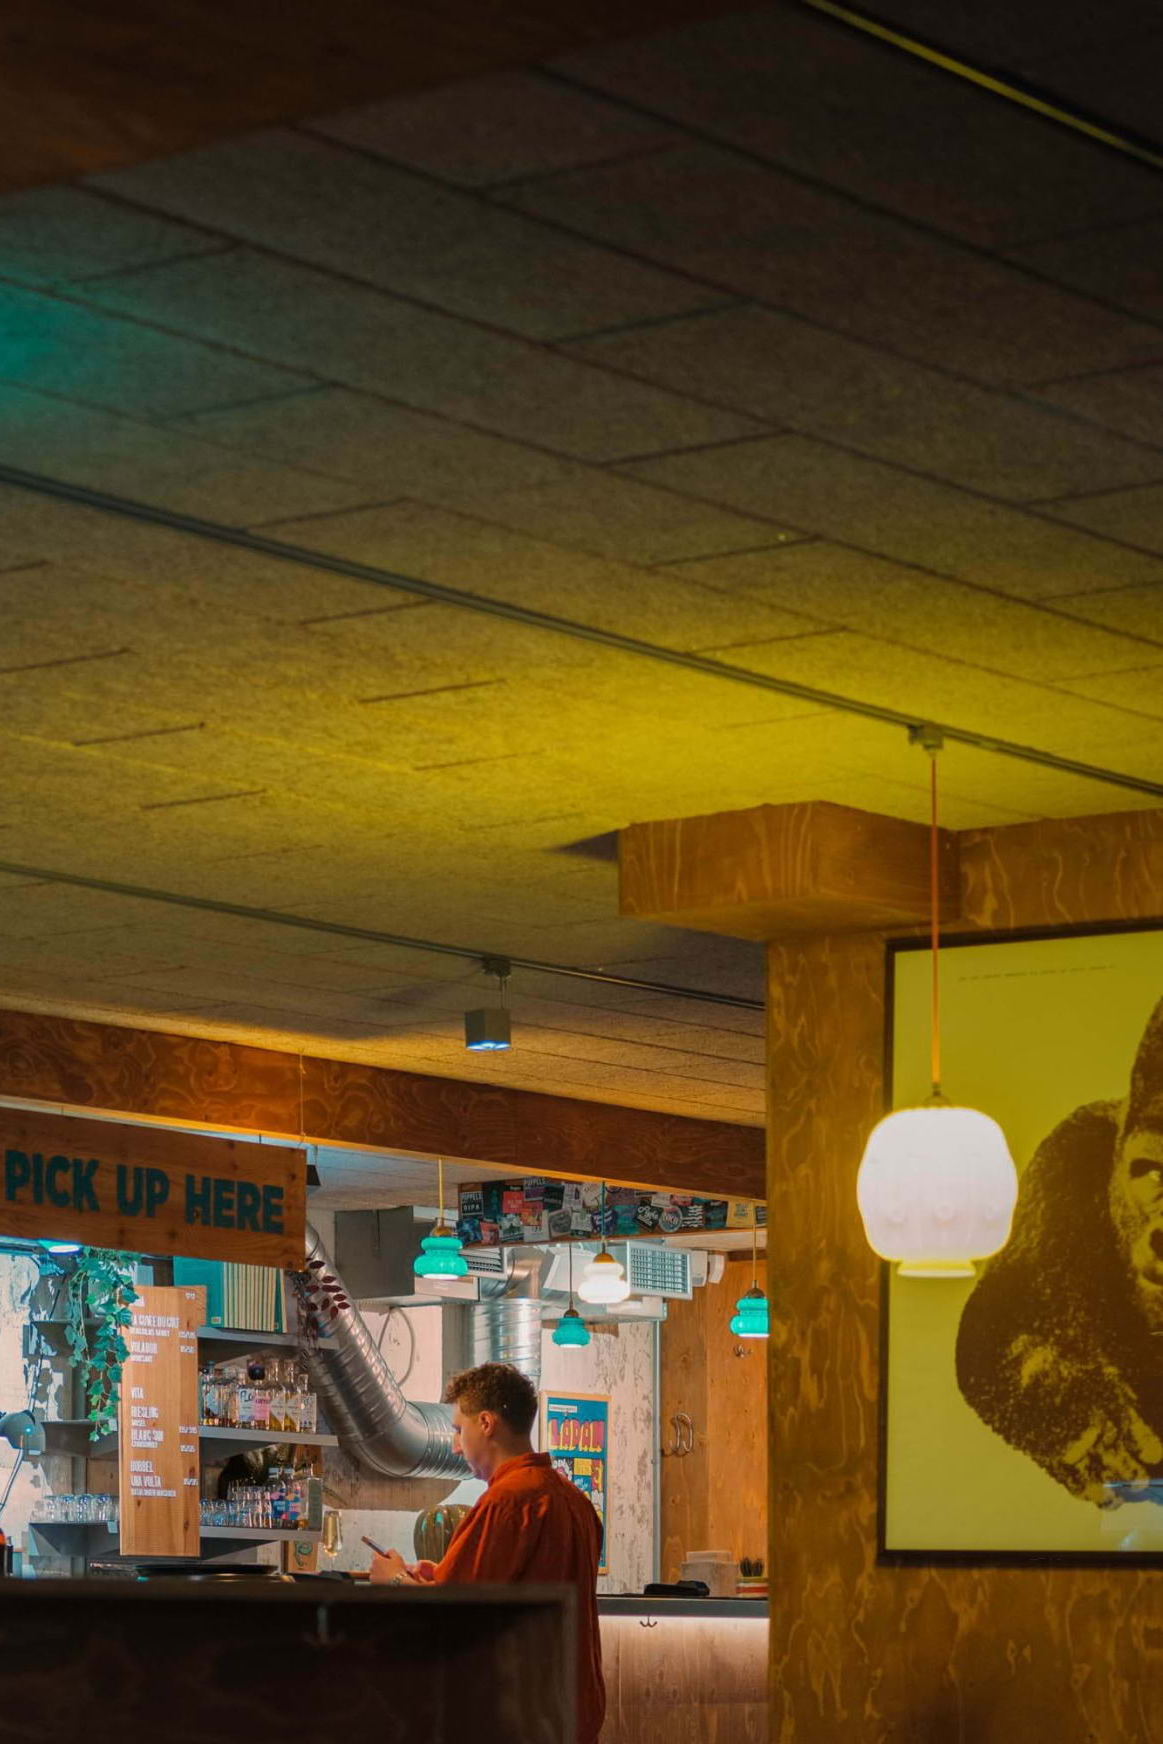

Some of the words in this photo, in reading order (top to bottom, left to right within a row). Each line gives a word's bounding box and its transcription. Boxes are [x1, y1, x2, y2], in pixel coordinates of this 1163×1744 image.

[5, 1149, 99, 1213] PICK
[116, 1164, 170, 1218] UP
[185, 1174, 285, 1235] HERE
